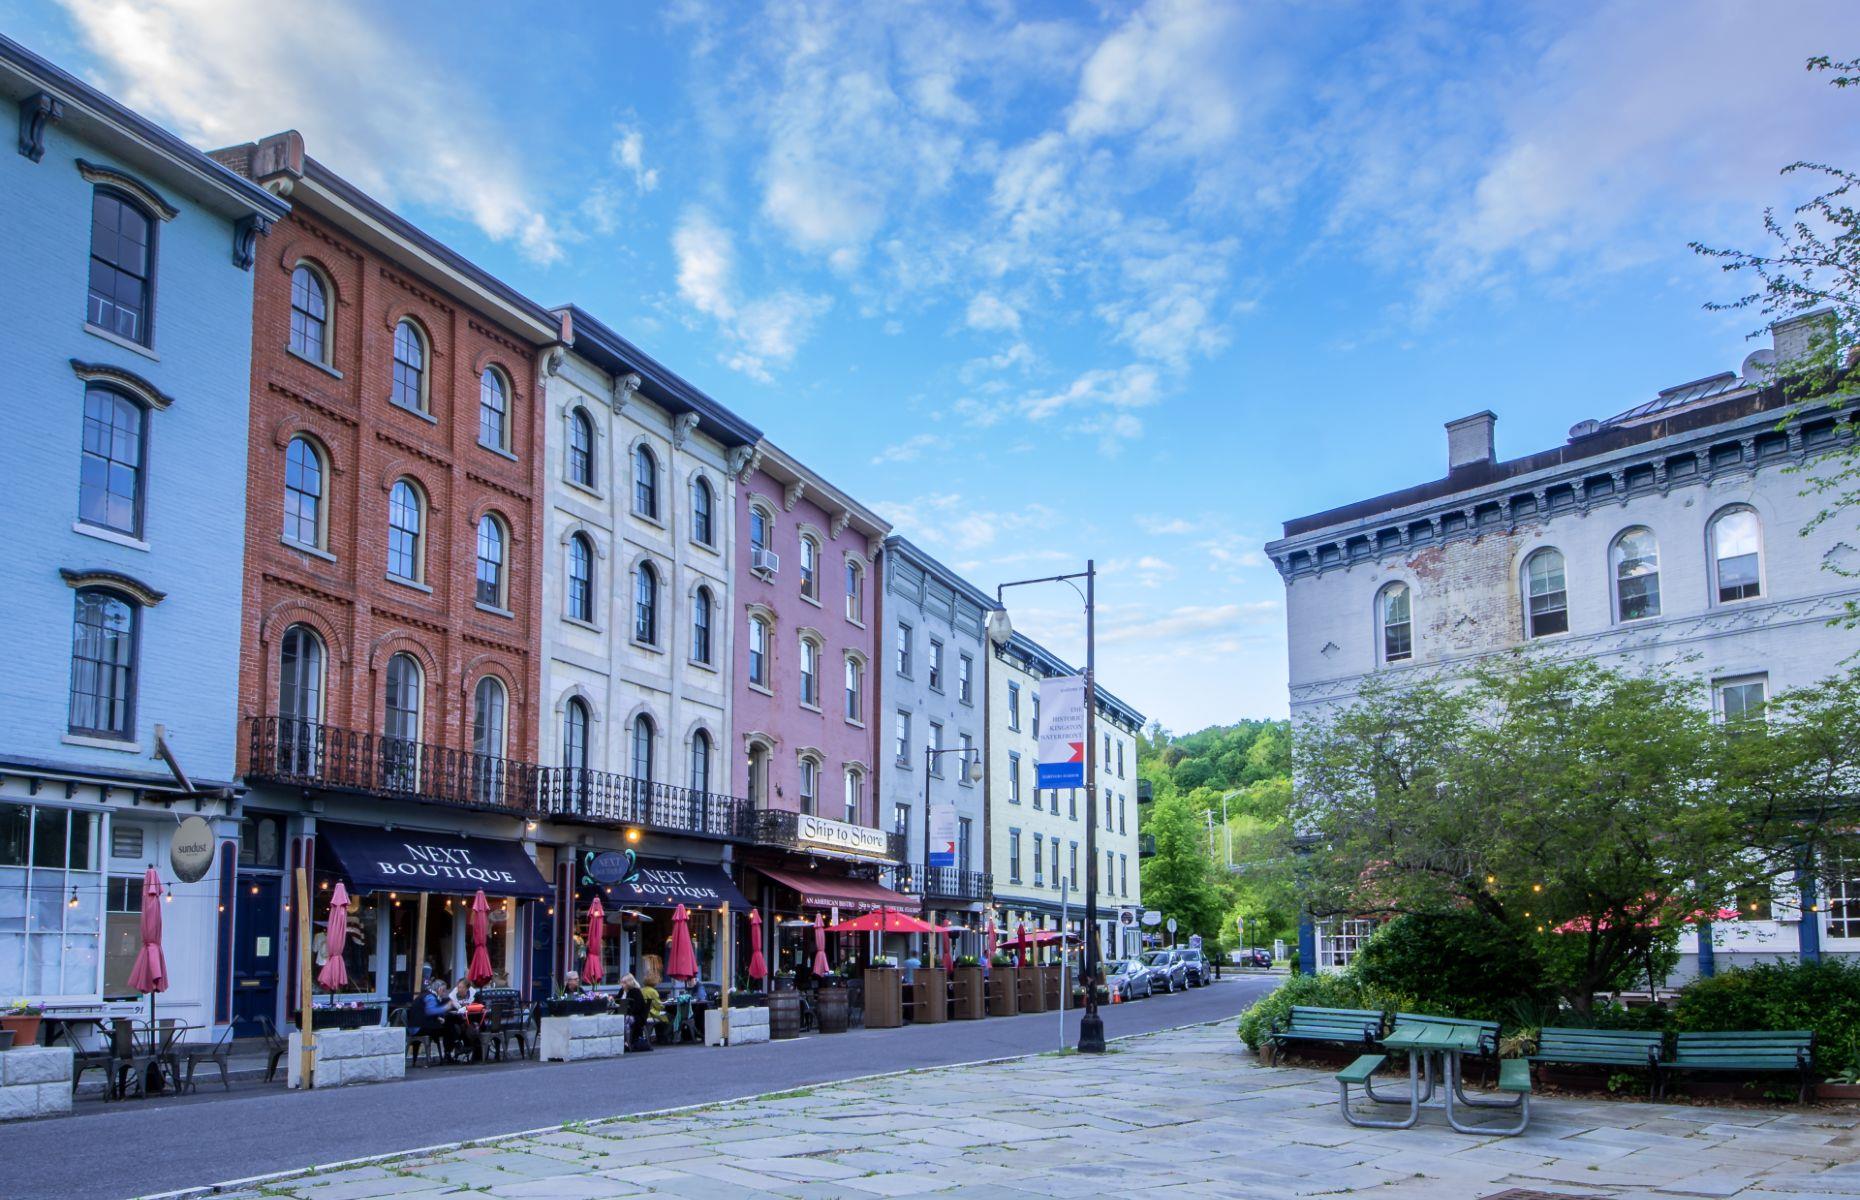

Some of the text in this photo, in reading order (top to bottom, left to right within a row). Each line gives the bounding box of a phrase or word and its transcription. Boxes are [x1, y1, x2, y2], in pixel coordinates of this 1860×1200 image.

[1052, 715, 1082, 723] HISTORIC
[1049, 723, 1083, 732] KINGSTON
[805, 817, 883, 847] Ship to Shore
[177, 841, 207, 854] sundust
[403, 843, 472, 865] NEXT
[599, 856, 621, 867] NEXT
[377, 862, 516, 883] BOUTIQUE
[642, 868, 688, 885] NEXT
[630, 883, 719, 899] BOUTIQUE
[805, 897, 814, 905] AN
[813, 898, 839, 907] AMERICAN
